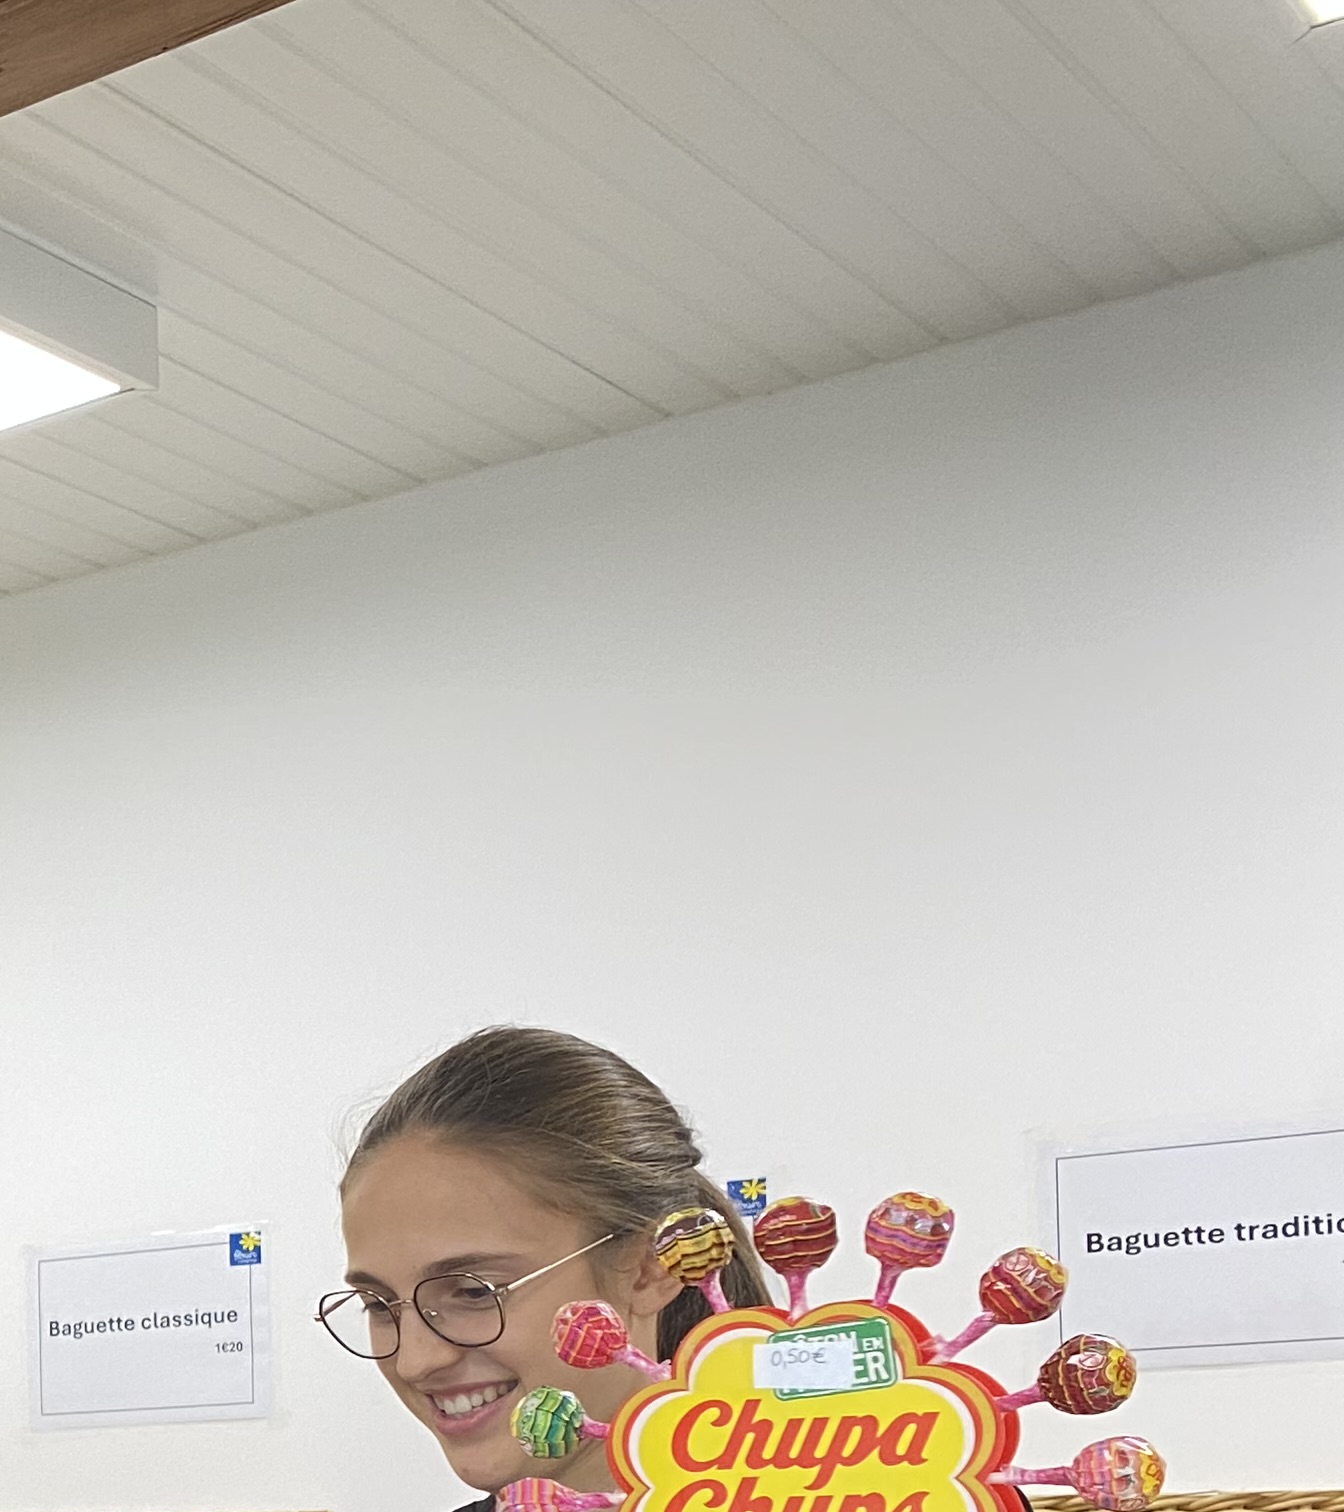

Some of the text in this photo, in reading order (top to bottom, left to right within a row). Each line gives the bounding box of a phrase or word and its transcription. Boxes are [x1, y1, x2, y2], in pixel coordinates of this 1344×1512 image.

[1086, 1226, 1224, 1255] Baguette
[48, 1308, 238, 1339] Baguette classique
[215, 1341, 243, 1354] 1€20
[770, 1348, 826, 1369] 0,50€
[672, 1400, 939, 1489] Chupa
